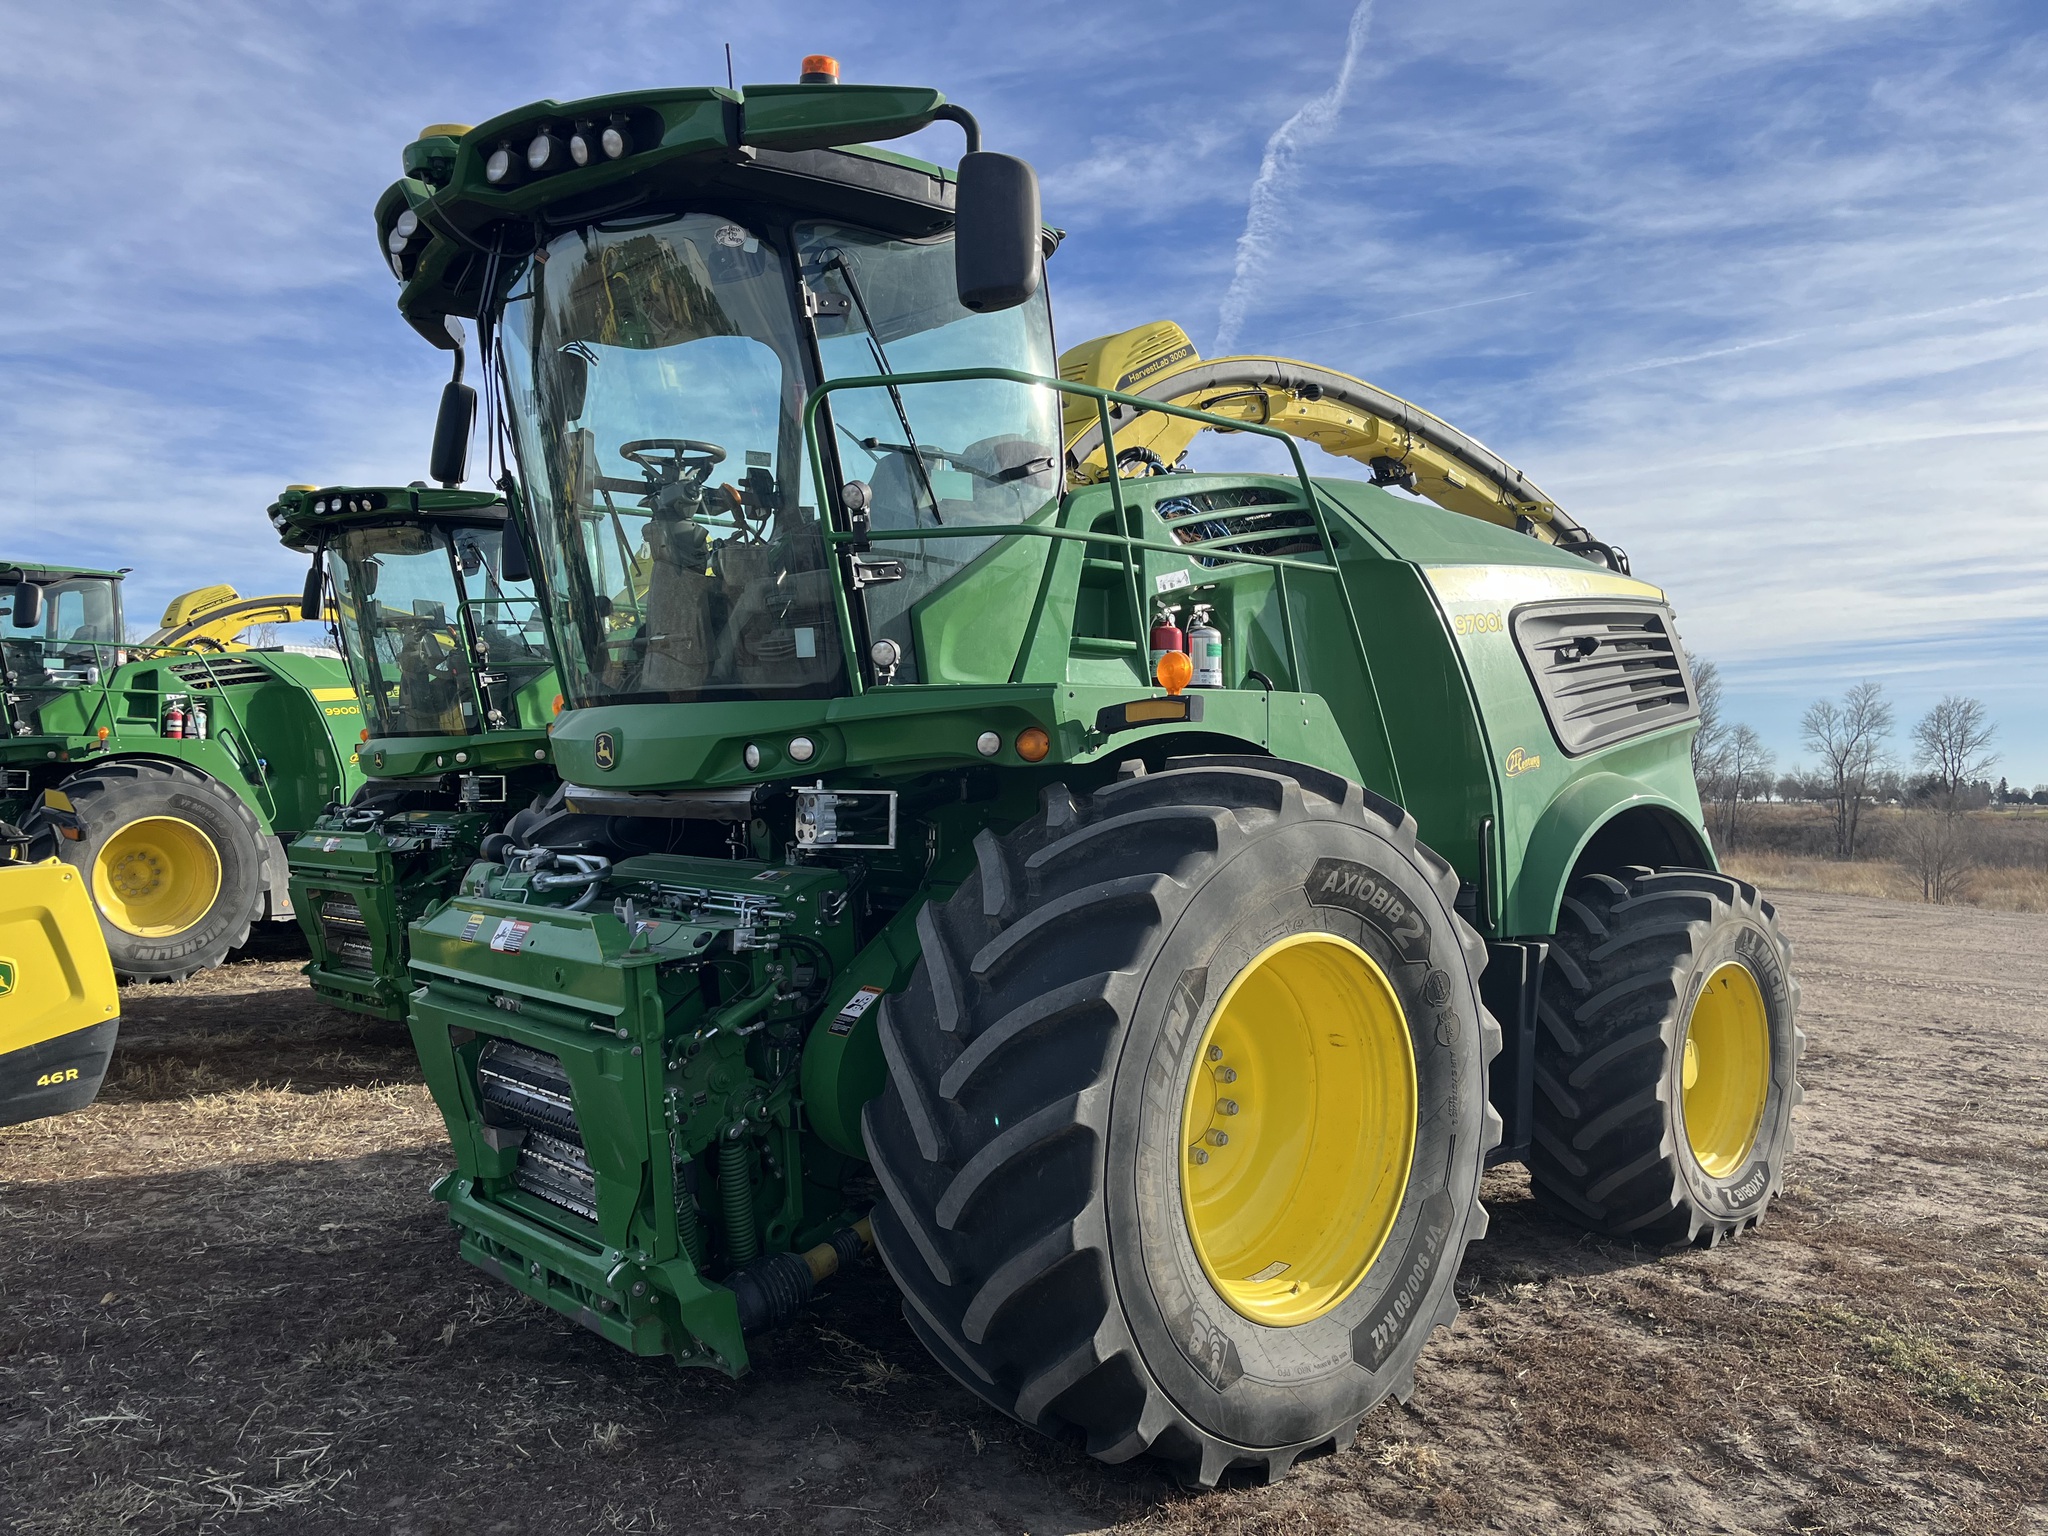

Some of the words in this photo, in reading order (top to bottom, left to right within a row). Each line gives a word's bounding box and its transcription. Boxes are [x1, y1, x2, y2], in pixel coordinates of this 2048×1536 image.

[1128, 357, 1170, 383] HarvestLab
[1169, 348, 1187, 364] 3000
[1454, 609, 1503, 635] 9700i
[324, 704, 360, 716] 9900i
[1320, 870, 1405, 923] AXIOBIB
[1391, 911, 1425, 950] 2
[134, 917, 229, 960] MICHELIN
[36, 1068, 79, 1087] 46R
[1139, 988, 1191, 1319] MICHELIN
[1721, 1188, 1740, 1208] 2
[1733, 1168, 1766, 1202] AXIOBIB
[1425, 1225, 1441, 1254] VF
[1393, 1252, 1430, 1319] 900/60
[1370, 1310, 1399, 1350] R42
